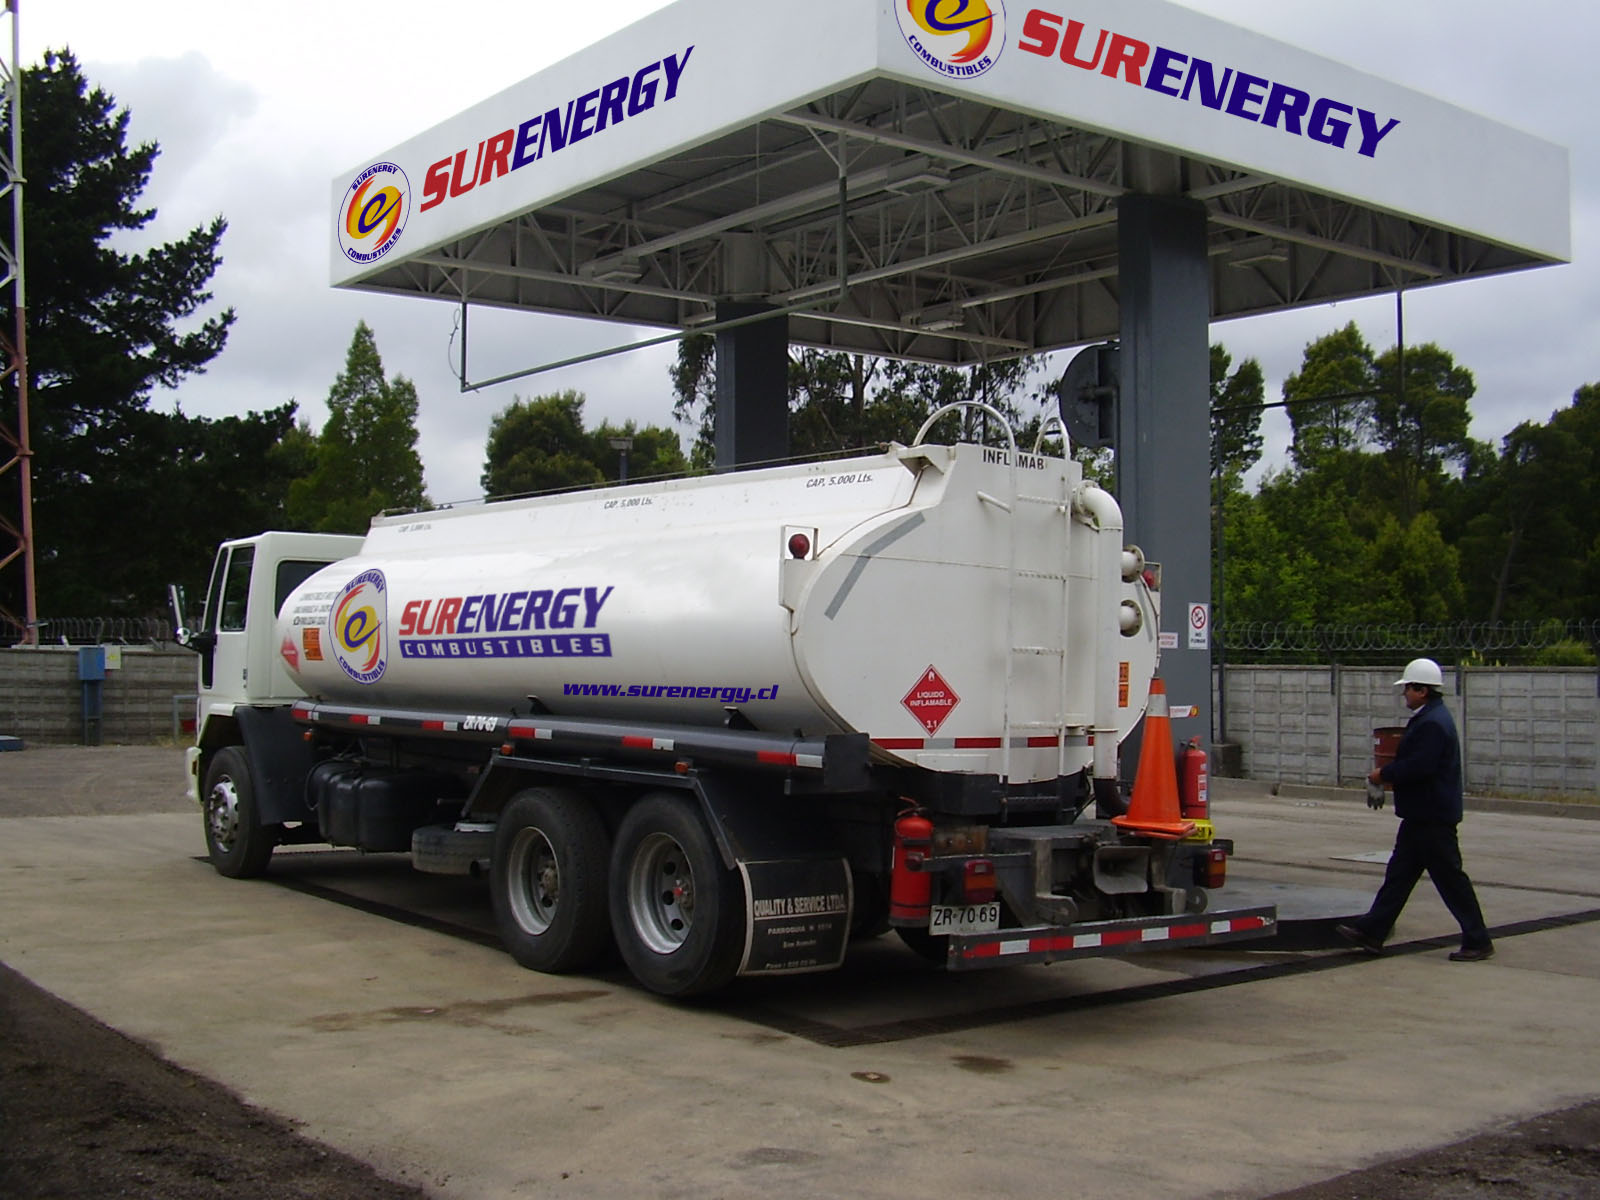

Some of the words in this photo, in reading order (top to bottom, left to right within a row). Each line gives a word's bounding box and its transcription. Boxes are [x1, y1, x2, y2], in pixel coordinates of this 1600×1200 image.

[908, 34, 992, 76] COMBUSTIBLES
[1018, 8, 1400, 158] SURENERGY
[420, 45, 695, 213] SURENERGY
[352, 164, 398, 191] SURENERGY
[347, 227, 402, 261] COMBUSTIBLES
[828, 474, 856, 486] 5.000
[345, 571, 385, 593] SURENERGY
[399, 586, 614, 635] SURENERGY
[404, 637, 605, 657] COMBUSTIBLES
[339, 656, 385, 681] COMBUSTIBLES
[563, 683, 779, 704] www.surenergy.cl
[910, 698, 952, 706] INFLAMABLE
[754, 898, 785, 917] QUALITY
[787, 898, 793, 914] &
[794, 895, 825, 913] SERVICE
